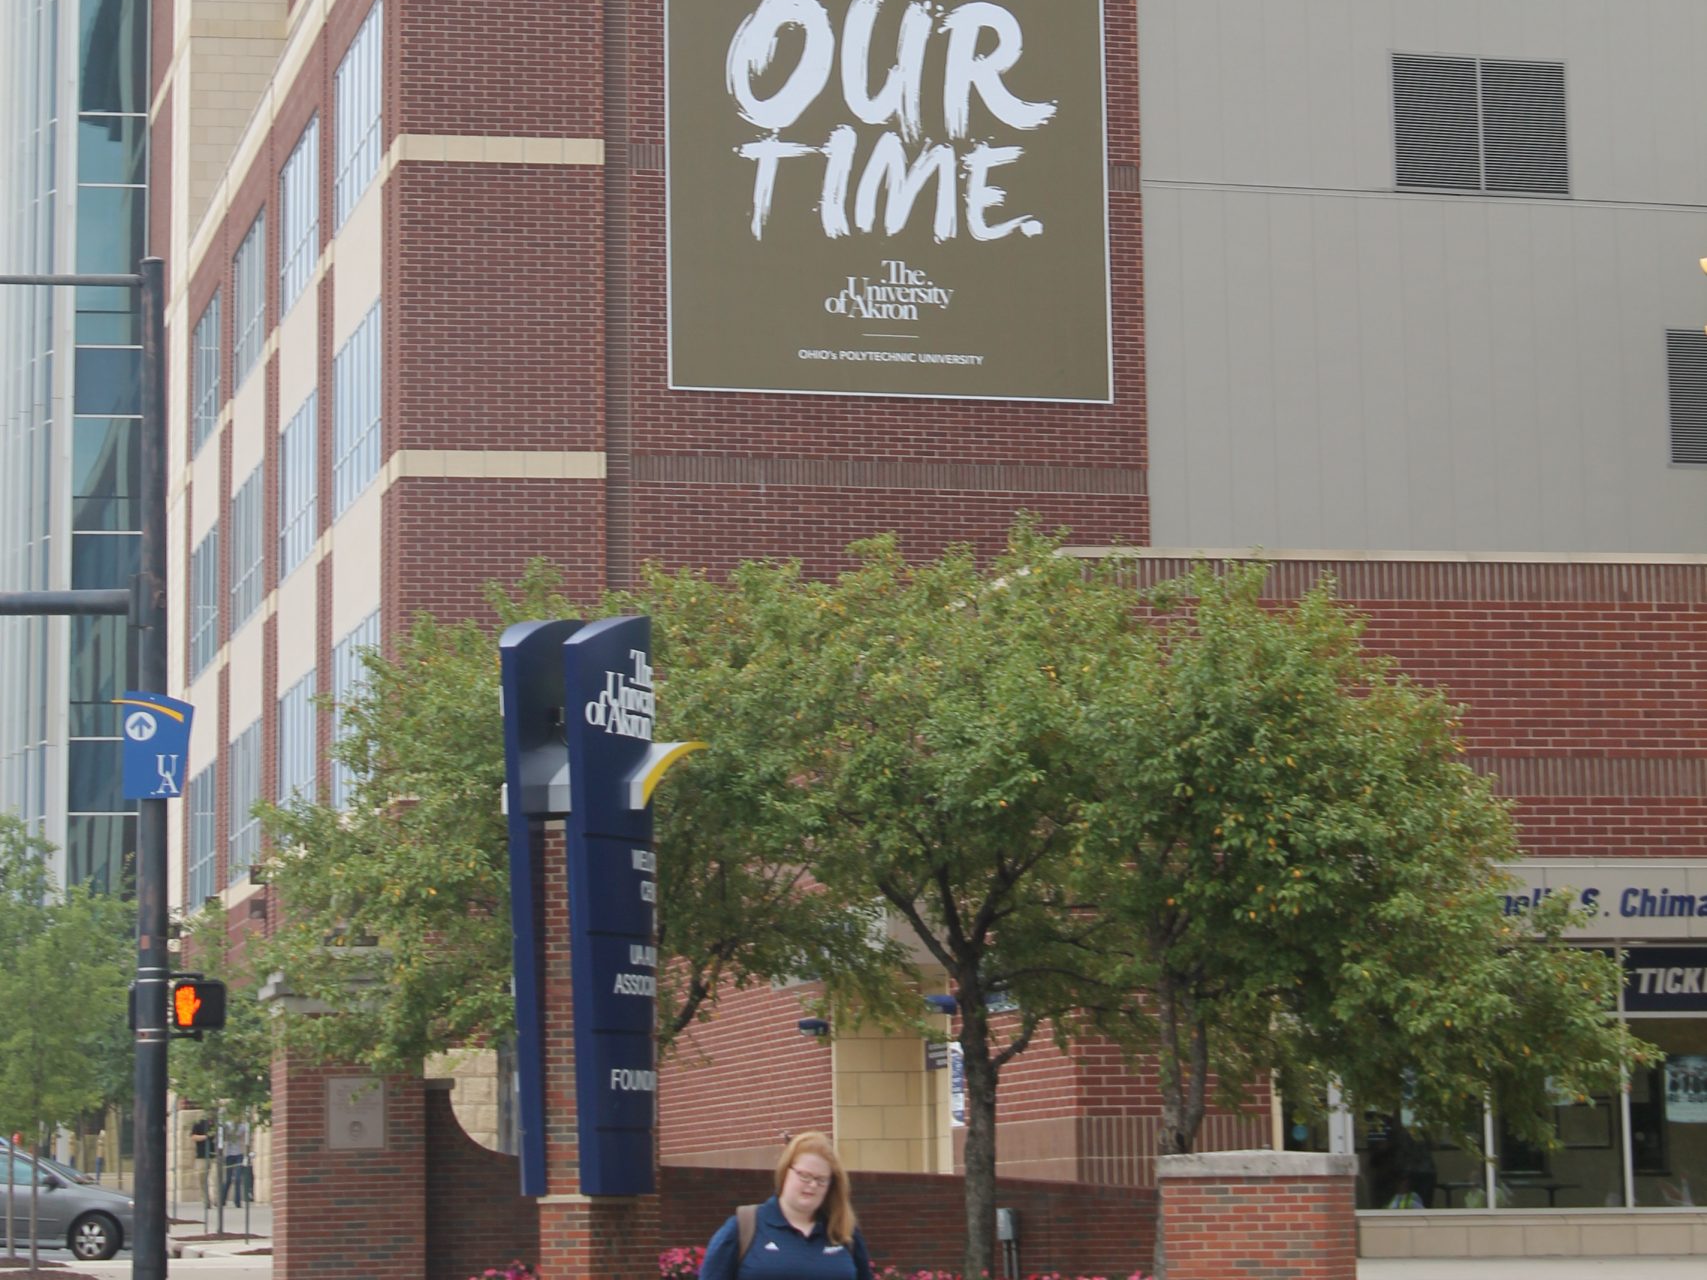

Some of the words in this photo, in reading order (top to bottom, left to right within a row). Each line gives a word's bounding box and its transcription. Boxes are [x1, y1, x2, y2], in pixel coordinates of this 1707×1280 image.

[732, 124, 1043, 242] TIME.
[825, 290, 849, 314] of
[848, 294, 919, 320] Akron
[847, 277, 954, 309] University
[839, 351, 917, 363] POLYTECHNIC
[918, 354, 984, 365] UNIVERSITY
[585, 690, 608, 726] of
